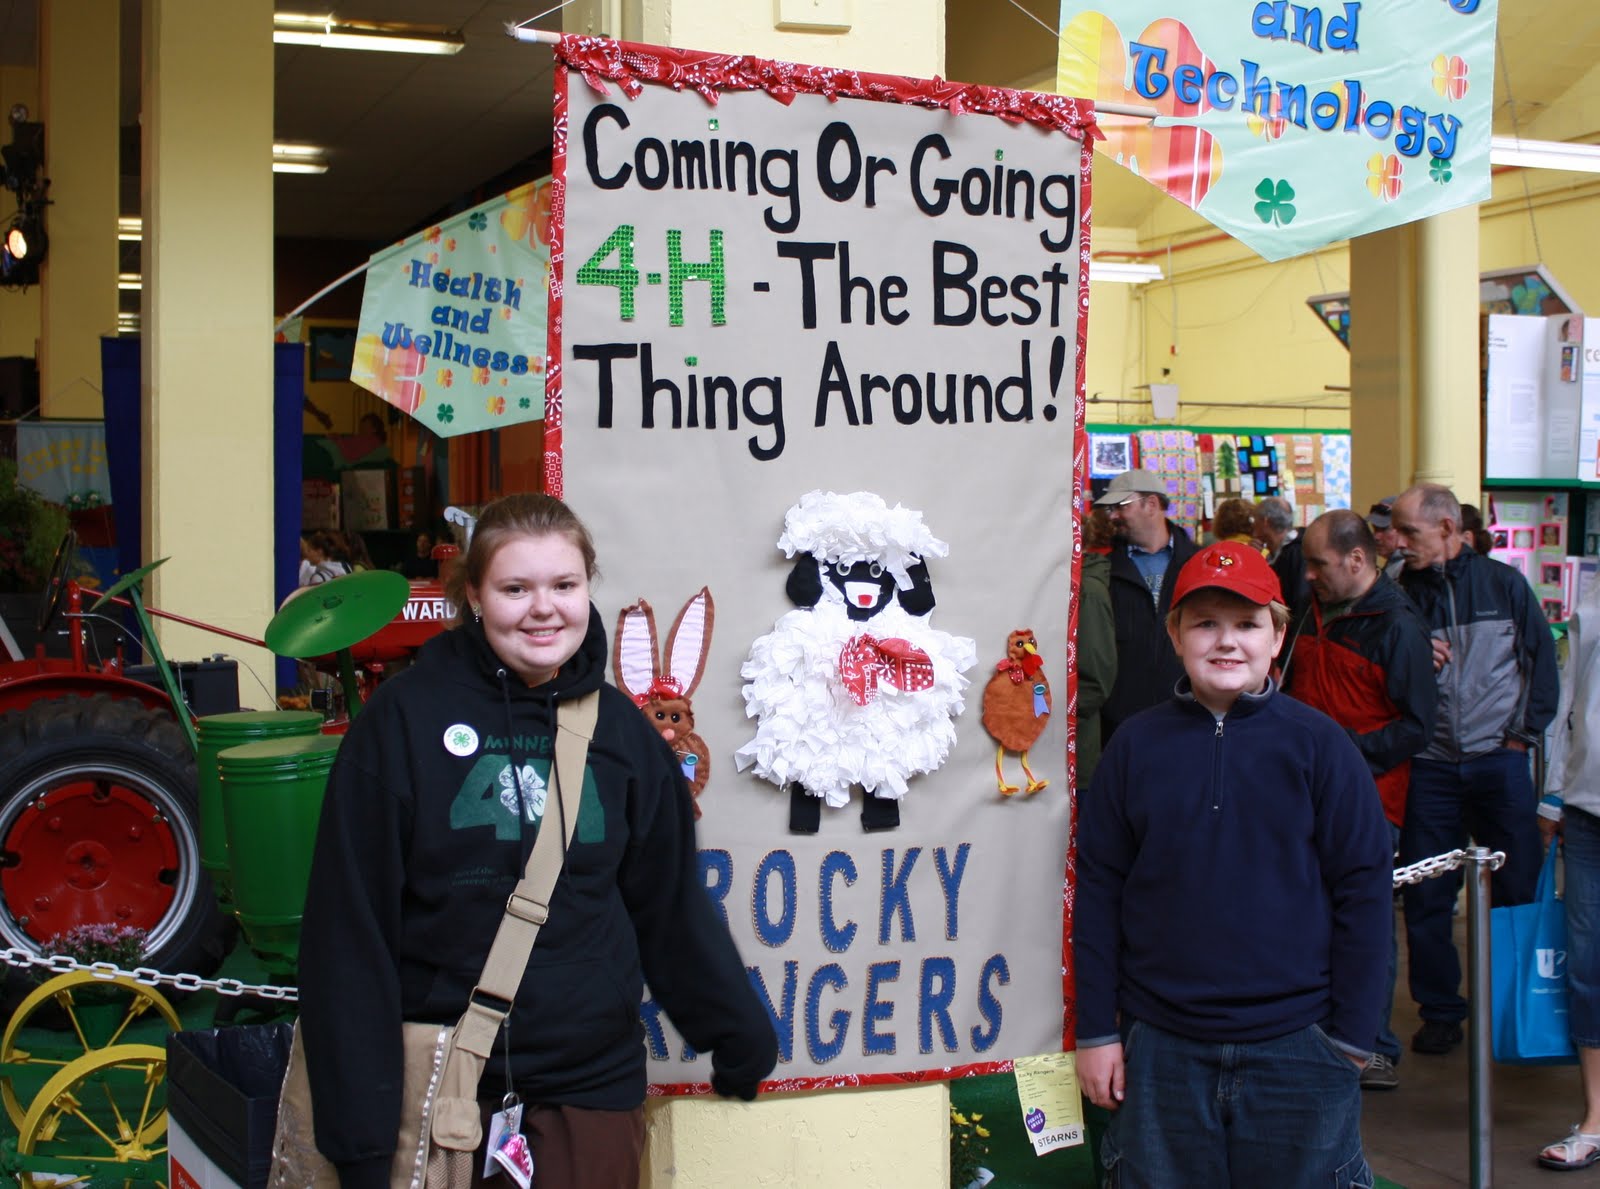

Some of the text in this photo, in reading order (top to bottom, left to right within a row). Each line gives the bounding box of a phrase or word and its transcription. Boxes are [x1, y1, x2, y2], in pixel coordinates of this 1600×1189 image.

[1251, 0, 1360, 53] and
[1129, 41, 1463, 160] Technology
[582, 103, 1076, 253] Coming Or Going
[409, 258, 522, 311] Health
[575, 224, 727, 327] 4-H
[933, 240, 1069, 328] Best
[381, 321, 529, 376] Wellness
[431, 304, 493, 334] and
[572, 335, 1066, 461] Thing Around!
[484, 734, 553, 753] MINNE
[696, 842, 972, 954] ROCKY
[640, 952, 1011, 1064] NGERS
[1037, 1130, 1079, 1148] STEARNS
